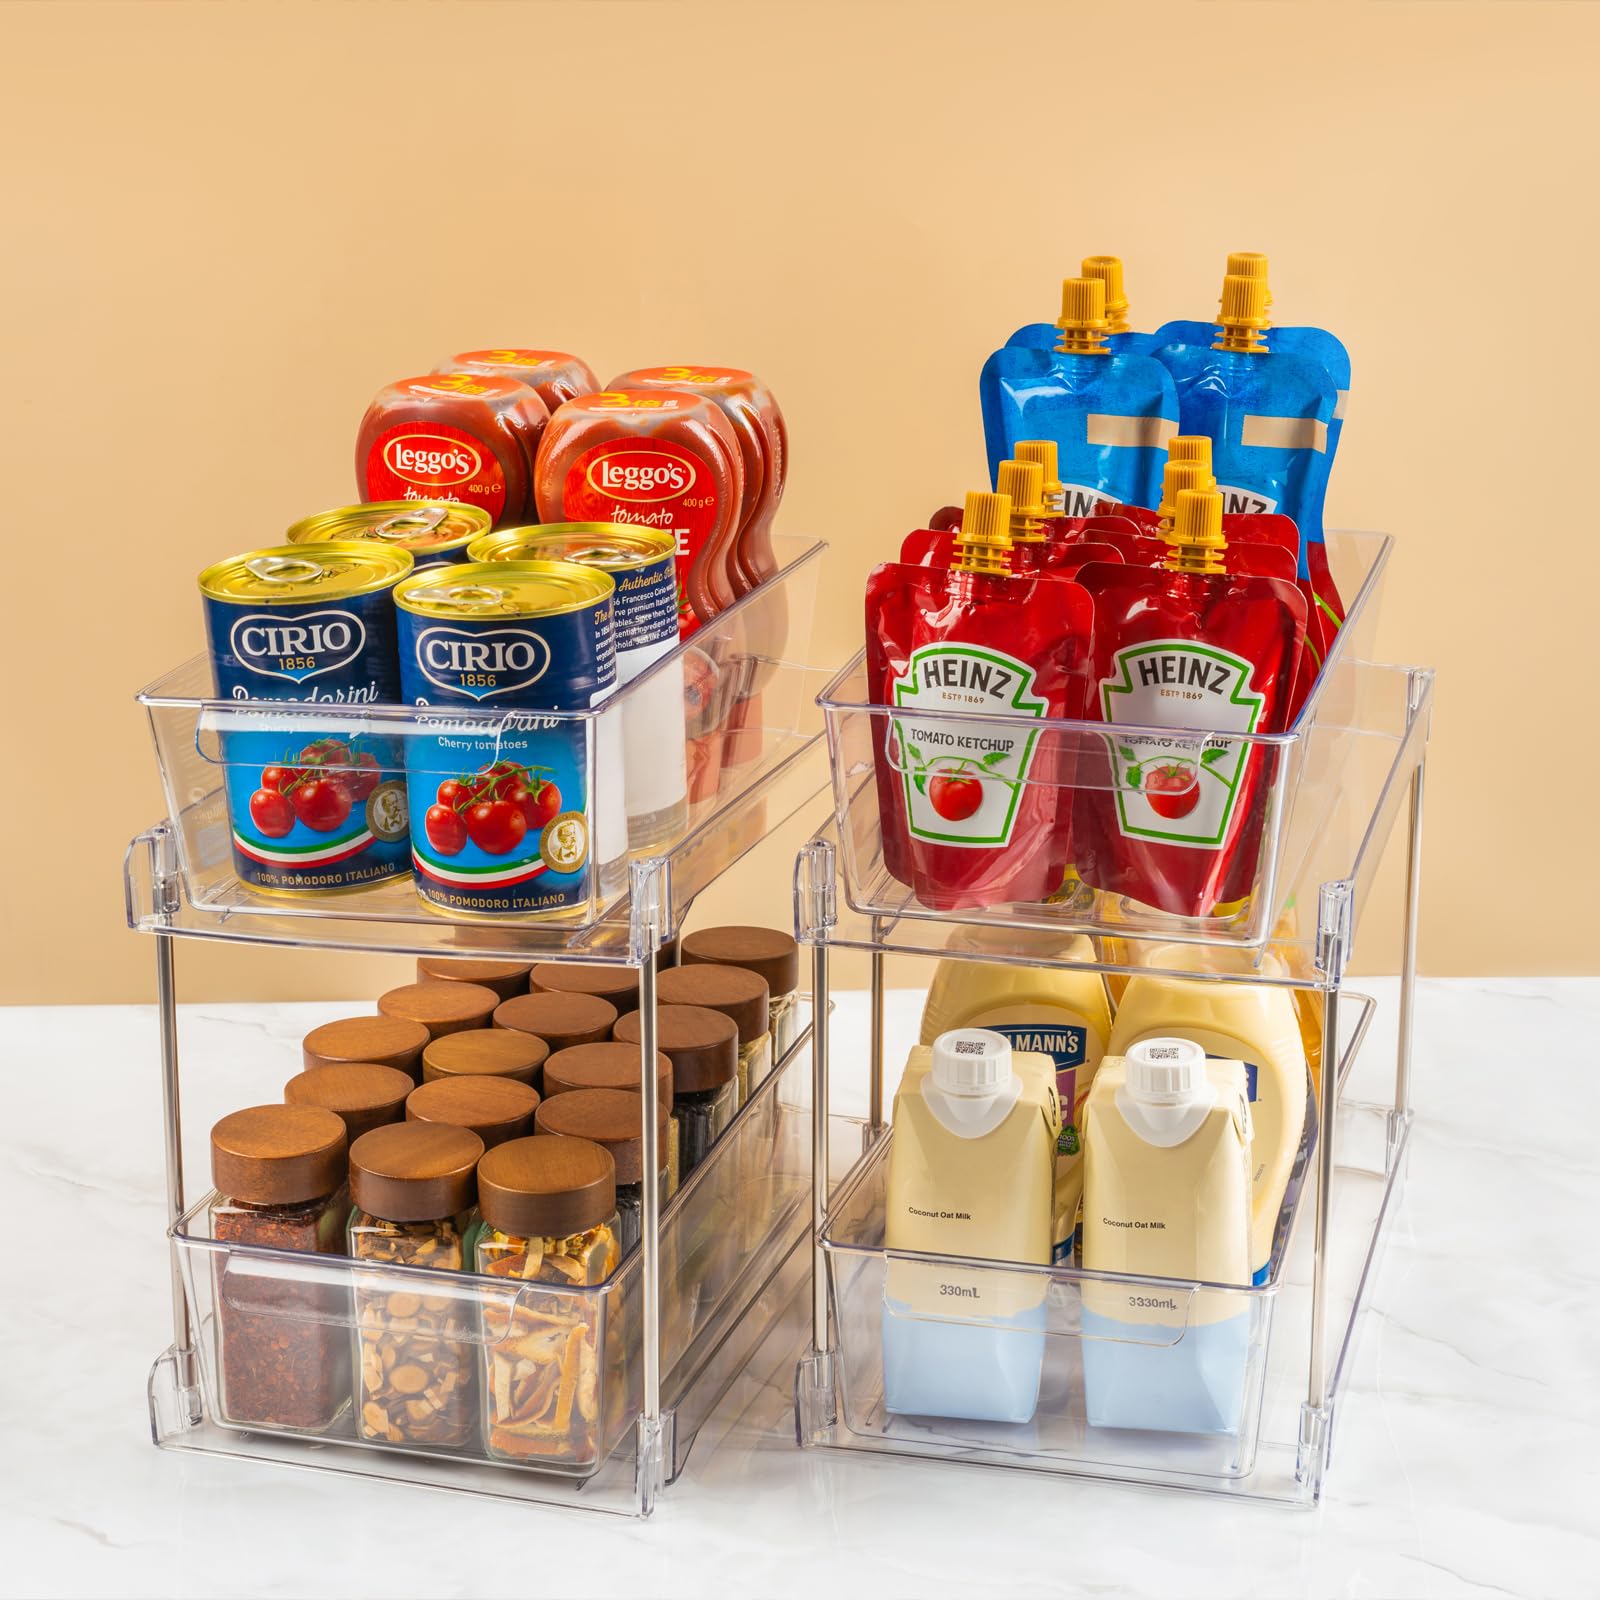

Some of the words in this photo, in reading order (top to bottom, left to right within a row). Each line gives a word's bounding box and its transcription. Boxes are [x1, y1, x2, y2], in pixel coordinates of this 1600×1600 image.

[396, 443, 469, 474] Leggo's
[602, 461, 684, 489] Leggo's
[468, 484, 483, 493] 400
[682, 499, 697, 507] 400
[610, 505, 673, 524] tomato
[618, 571, 663, 591] Authentic
[622, 592, 654, 605] Francesco
[654, 586, 666, 596] Cirio
[628, 602, 655, 616] premium
[241, 622, 351, 657] CIRIO
[278, 656, 316, 671] 1856
[426, 640, 535, 672] CIRIO
[460, 673, 496, 687] 1856
[923, 659, 1012, 699] HEINZ
[1137, 656, 1231, 695] HEINZ
[964, 694, 985, 704] 1869
[1182, 692, 1203, 700] 1869
[438, 736, 472, 751] Cherry
[475, 740, 528, 750] tomatoes
[911, 728, 955, 746] TOMATO
[957, 736, 1014, 752] KETCHUP
[257, 872, 279, 884] 100%
[281, 873, 342, 886] POMODORO
[346, 863, 395, 882] ITALIANO
[428, 889, 448, 903] 100%
[449, 894, 509, 909] POMODORO
[513, 893, 565, 909] ITALIANO
[1008, 1030, 1079, 1053] LMANN'S
[908, 1206, 939, 1218] Coconut
[940, 1211, 954, 1219] Oat
[955, 1212, 971, 1220] Milk
[1102, 1217, 1133, 1228] Coconut
[1134, 1221, 1148, 1229] Oat
[1149, 1222, 1166, 1230] Milk
[939, 1284, 980, 1298] 330mL
